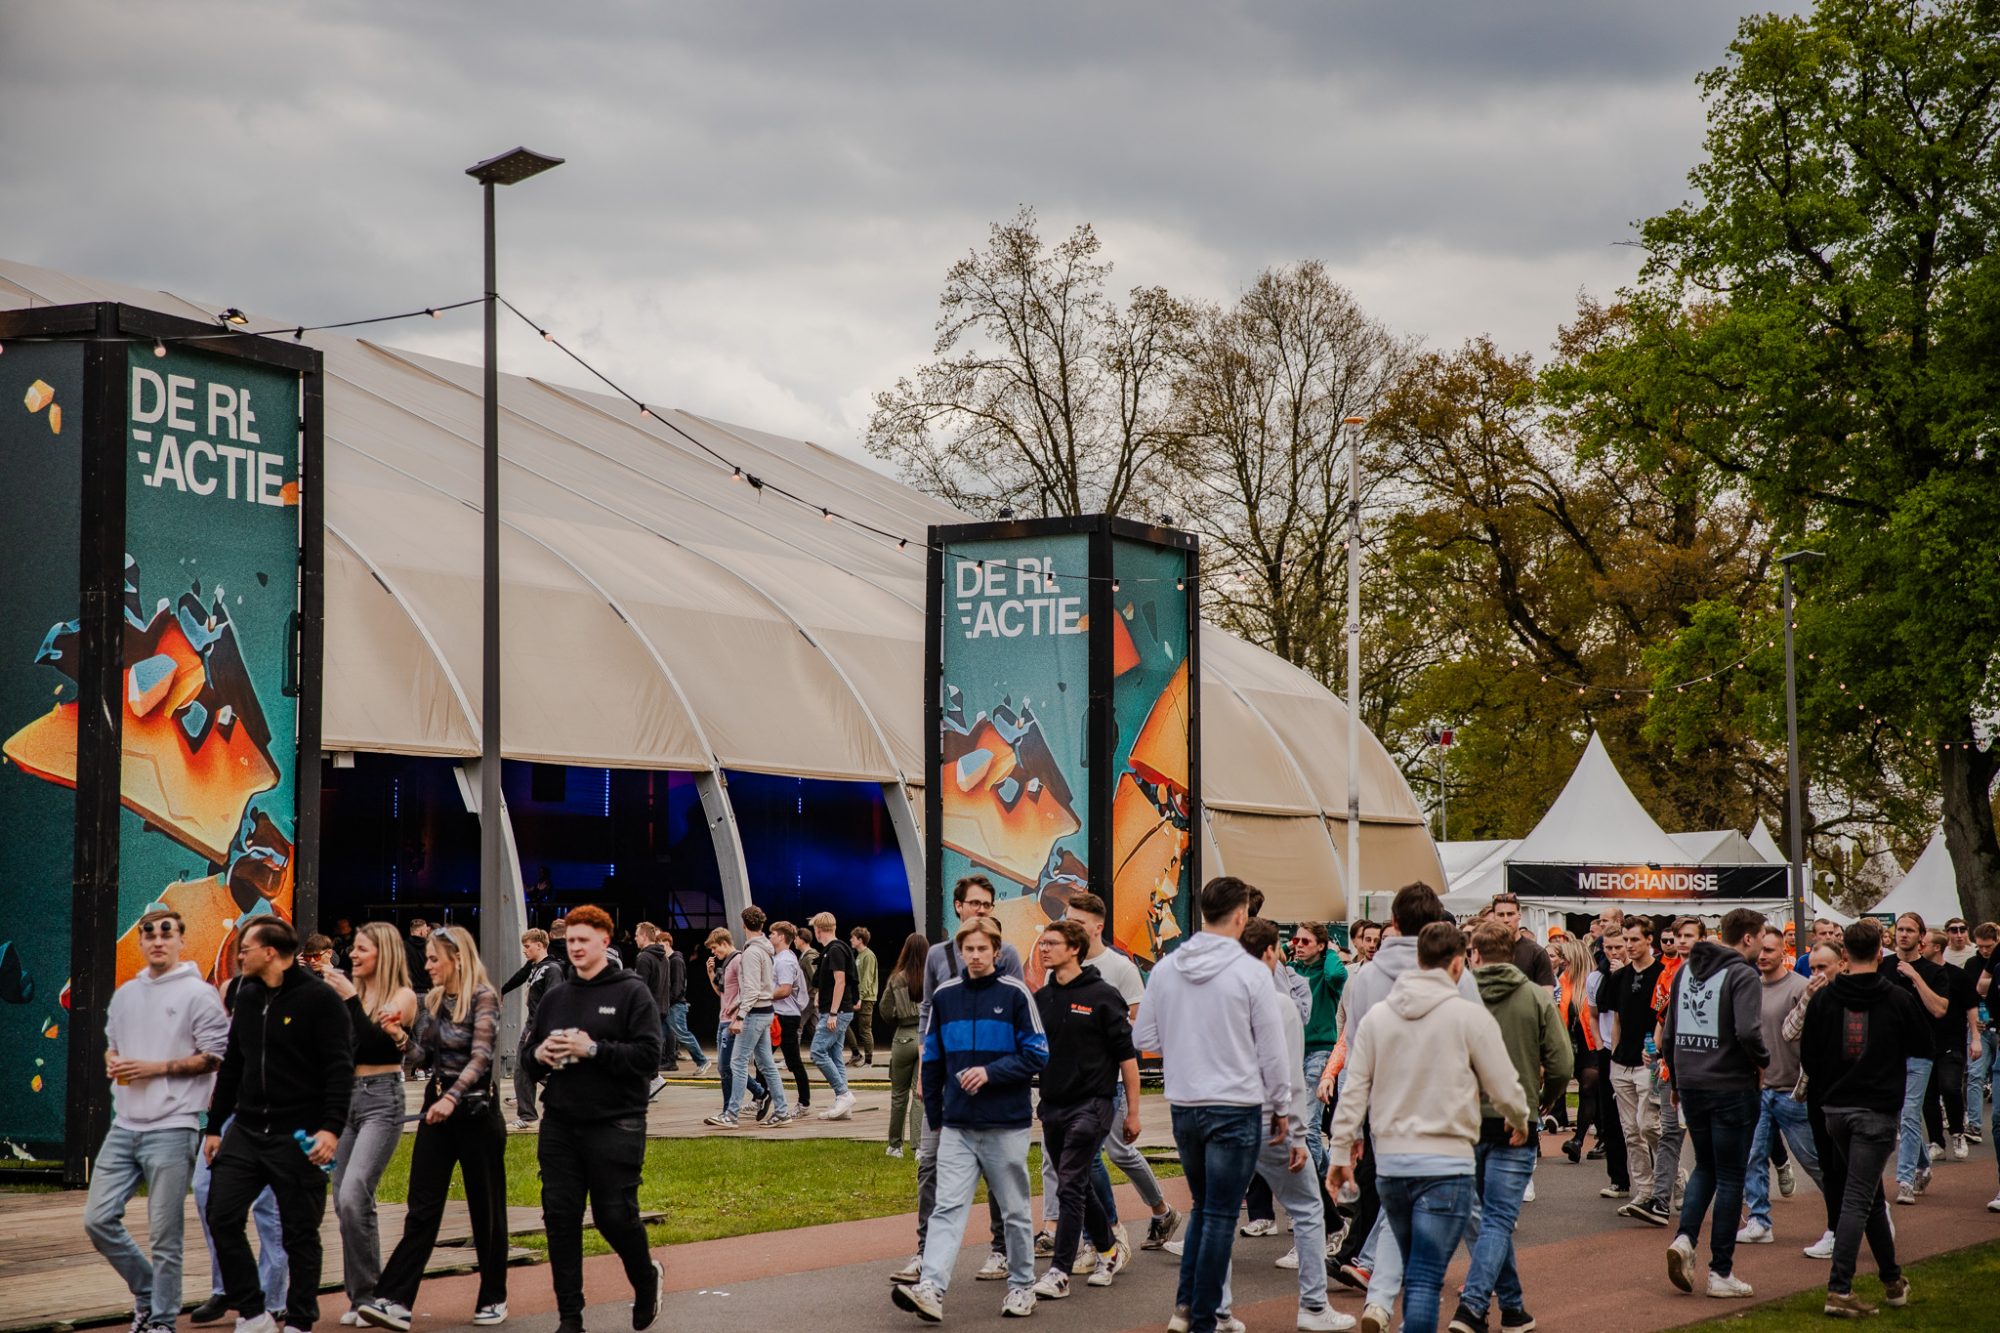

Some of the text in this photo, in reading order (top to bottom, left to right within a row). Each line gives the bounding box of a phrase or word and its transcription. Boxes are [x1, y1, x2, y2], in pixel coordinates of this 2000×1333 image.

[132, 366, 196, 432] DE
[956, 559, 1007, 598] DE
[1578, 872, 1719, 891] MERCHANDISE
[1675, 1035, 1719, 1049] REVIVE
